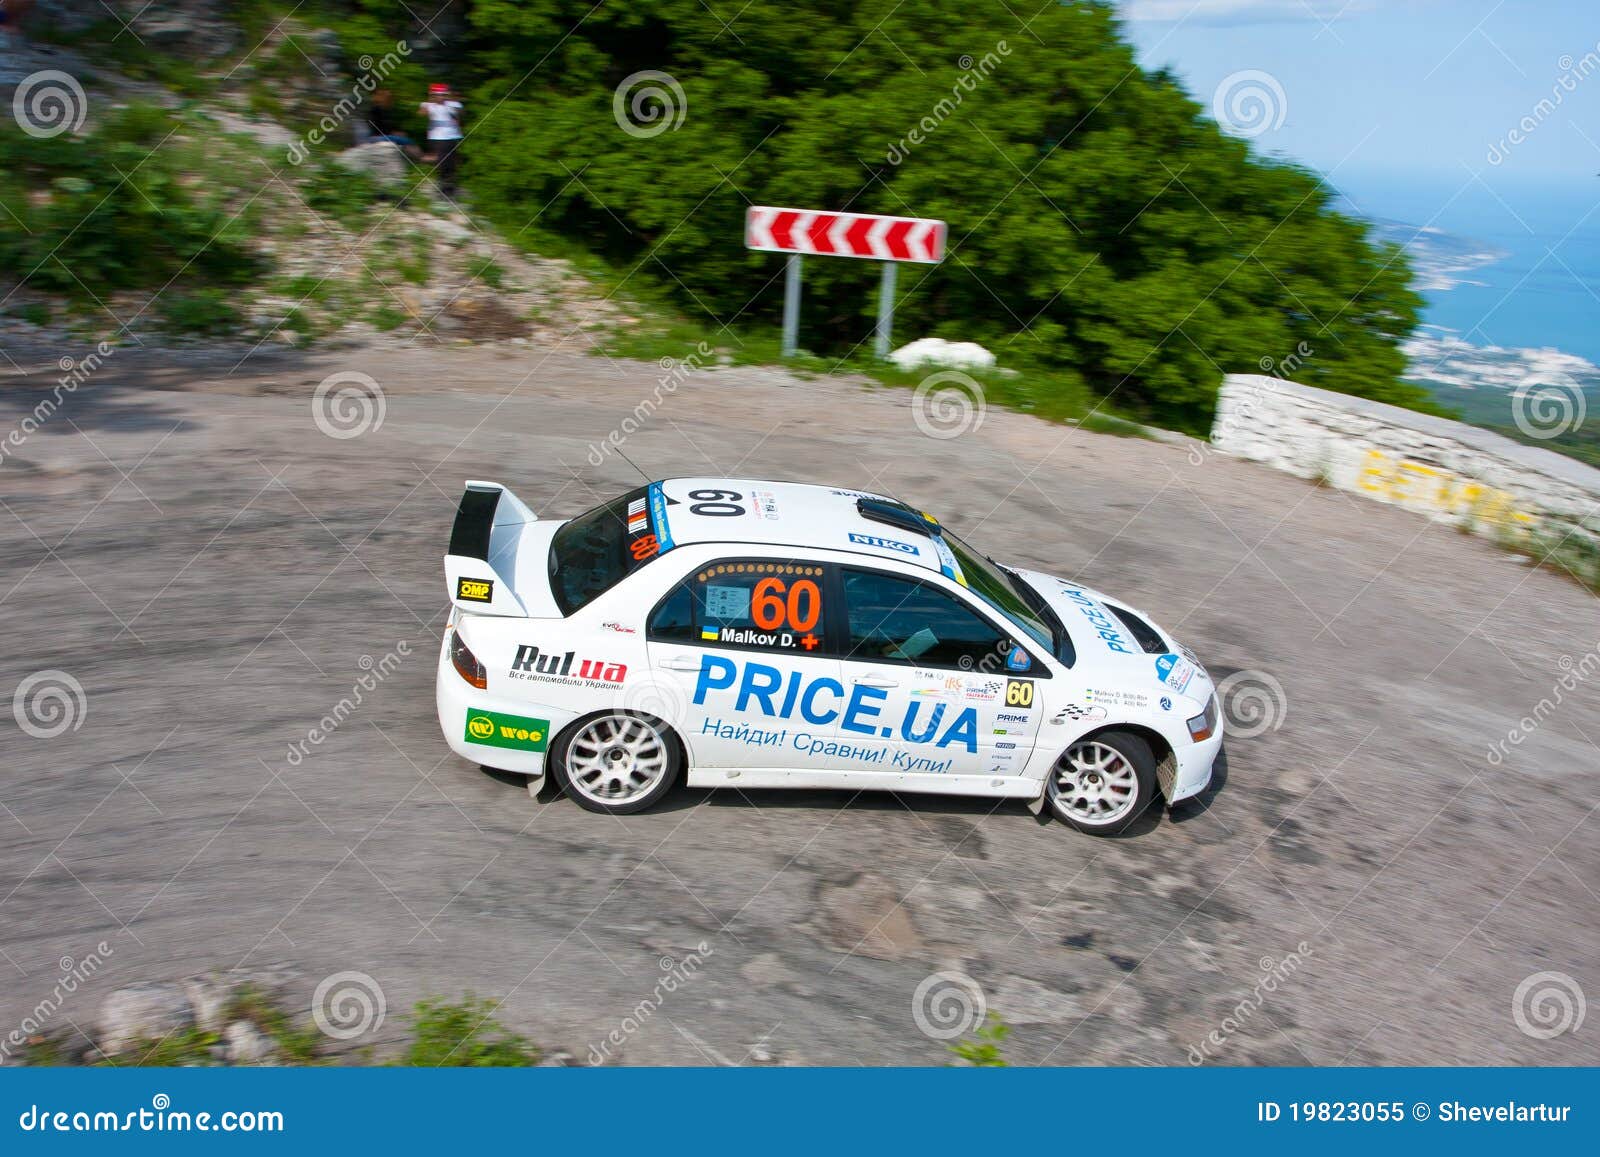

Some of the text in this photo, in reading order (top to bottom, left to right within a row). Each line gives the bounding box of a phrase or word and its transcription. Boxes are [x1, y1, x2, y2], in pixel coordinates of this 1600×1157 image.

[688, 489, 746, 517] 60
[630, 533, 661, 561] 60
[852, 534, 916, 553] NIKO
[460, 583, 489, 598] OMP
[751, 577, 821, 632] 60
[1063, 589, 1134, 654] PRICE.UA
[721, 628, 797, 647] Malkov D.
[511, 644, 628, 683] Rul.ua
[508, 670, 624, 691] Все автомобили Украины
[1006, 681, 1033, 706] 60
[692, 654, 978, 754] PRICE.UA
[996, 714, 1029, 723] PRIME
[702, 717, 953, 774] Найди! Сравни! Купи!
